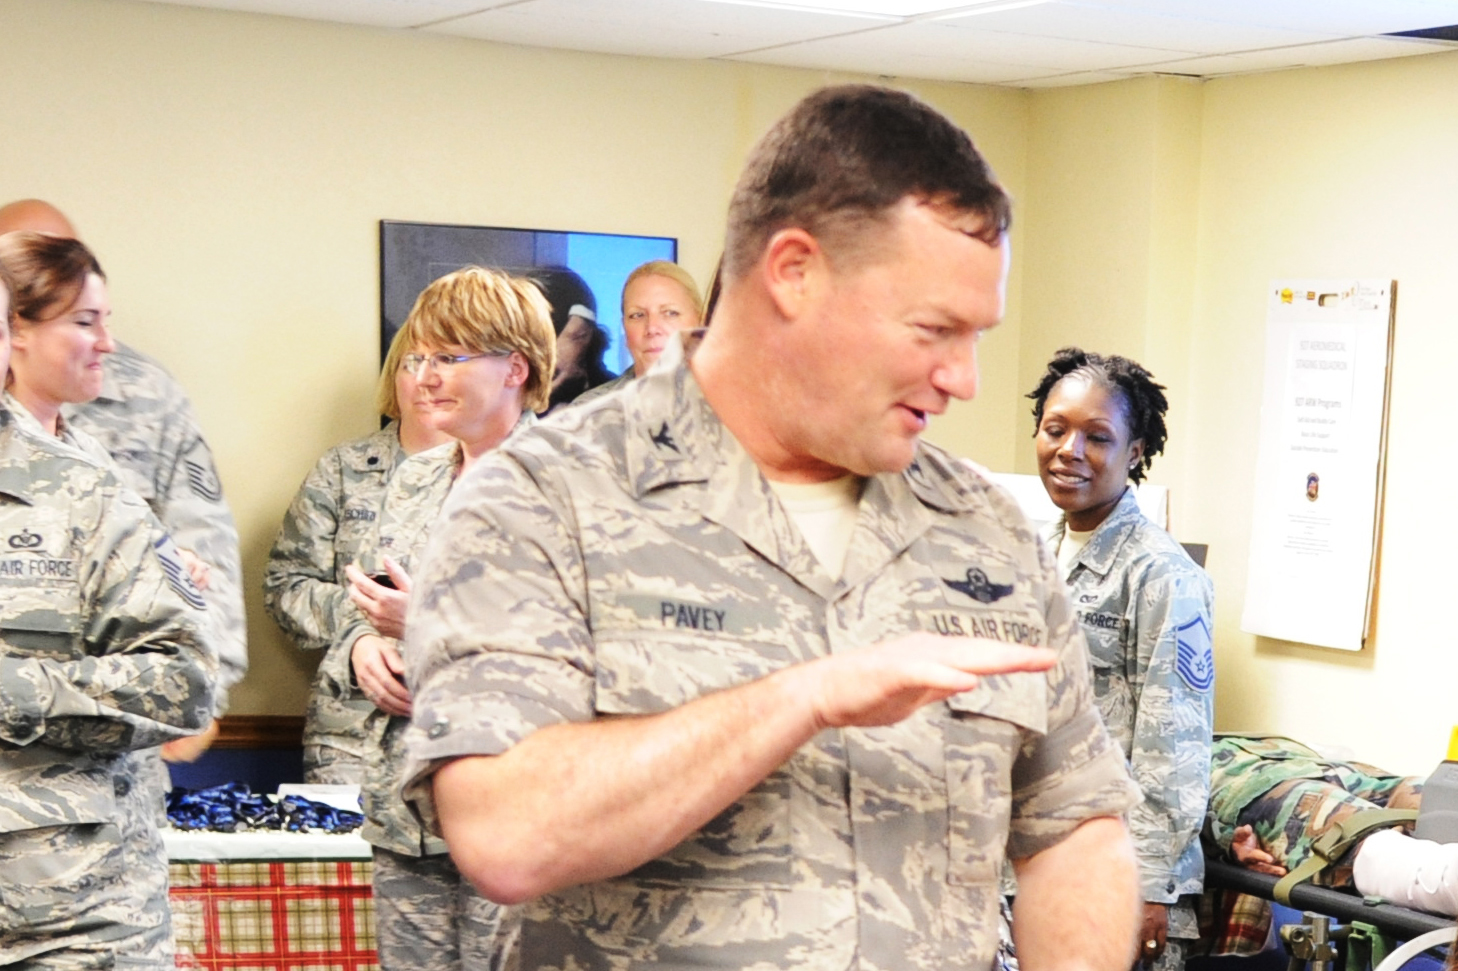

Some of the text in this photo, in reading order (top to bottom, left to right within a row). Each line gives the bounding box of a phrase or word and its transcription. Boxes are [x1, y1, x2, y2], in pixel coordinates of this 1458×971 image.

[1, 559, 72, 577] AIR FORCE
[660, 601, 725, 632] PAVEY
[1084, 612, 1119, 630] FORCE
[971, 617, 1001, 641] AIR
